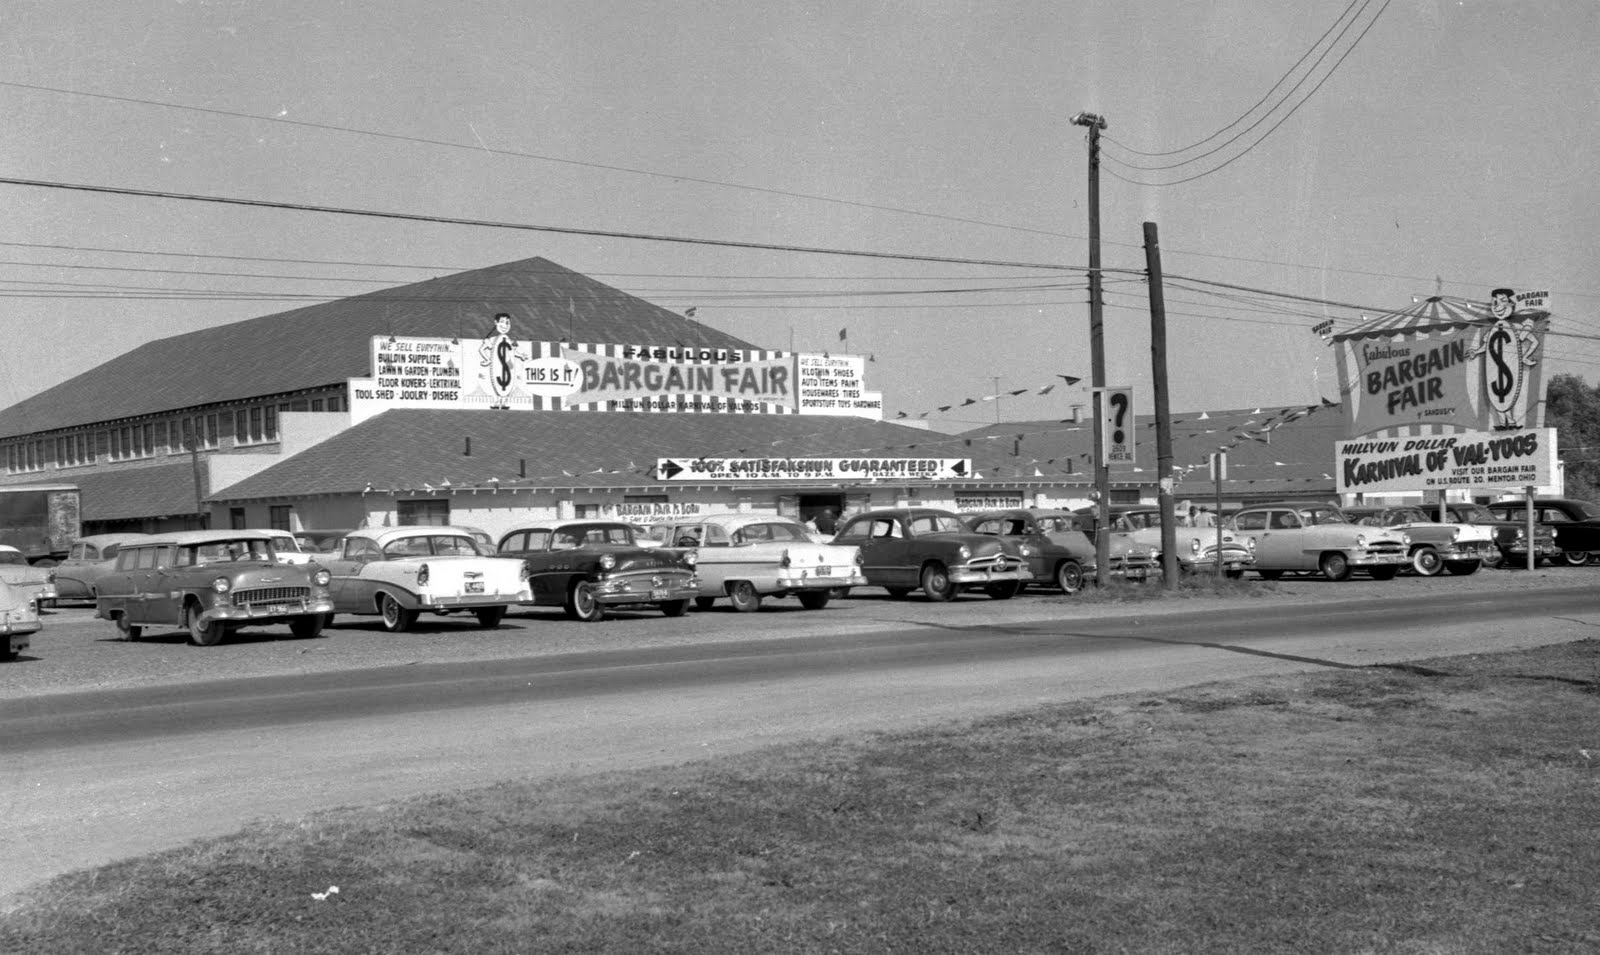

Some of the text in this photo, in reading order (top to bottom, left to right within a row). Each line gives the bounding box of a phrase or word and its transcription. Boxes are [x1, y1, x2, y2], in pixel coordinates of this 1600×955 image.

[1516, 291, 1549, 302] BARGAIN
[1525, 298, 1543, 307] FAIR
[380, 342, 392, 351] WE
[395, 342, 412, 352] SELL
[378, 353, 441, 364] BUILDIN SUPPLIZE
[623, 348, 741, 362] FABULOUS
[1362, 344, 1411, 366] fabulous
[378, 366, 396, 376] LAWN
[404, 366, 428, 376] GARDEN
[432, 367, 460, 377] PLUMBIN
[1367, 338, 1464, 395] BARGAIN
[525, 368, 579, 387] THIS IS IT!
[580, 359, 788, 395] BARGAIN FAIR
[802, 368, 854, 378] KLOTHIN SHOES
[378, 378, 462, 389] FLOOR KOVERS LEKTRIKAL
[802, 378, 860, 388] AUTO ITEMS PAINT
[355, 389, 458, 401] TOOL SHED JOOLRY DISHES
[802, 388, 860, 398] HOUSEWARES TIRES
[1388, 376, 1444, 416] FAIR
[611, 400, 644, 409] MILLYUN
[647, 401, 676, 410] DOLLAR
[678, 401, 716, 410] KARNIVAL
[717, 402, 726, 410] OF
[802, 398, 882, 410] SPORTSTUFF TOYS HARDWARE
[1342, 438, 1458, 455] MILLYUN DOLLAR
[691, 460, 944, 473] 100% SATISFAKSHUN GUARANTEED!
[1344, 454, 1424, 488] KARNIVAL
[1426, 449, 1448, 472] OF
[1452, 468, 1468, 476] VISIT
[1487, 466, 1519, 474] BARGAIN
[1449, 476, 1470, 484] ROUTE
[1518, 474, 1536, 482] OHIO
[616, 502, 700, 516] BARGAIN FAIR IS BORN
